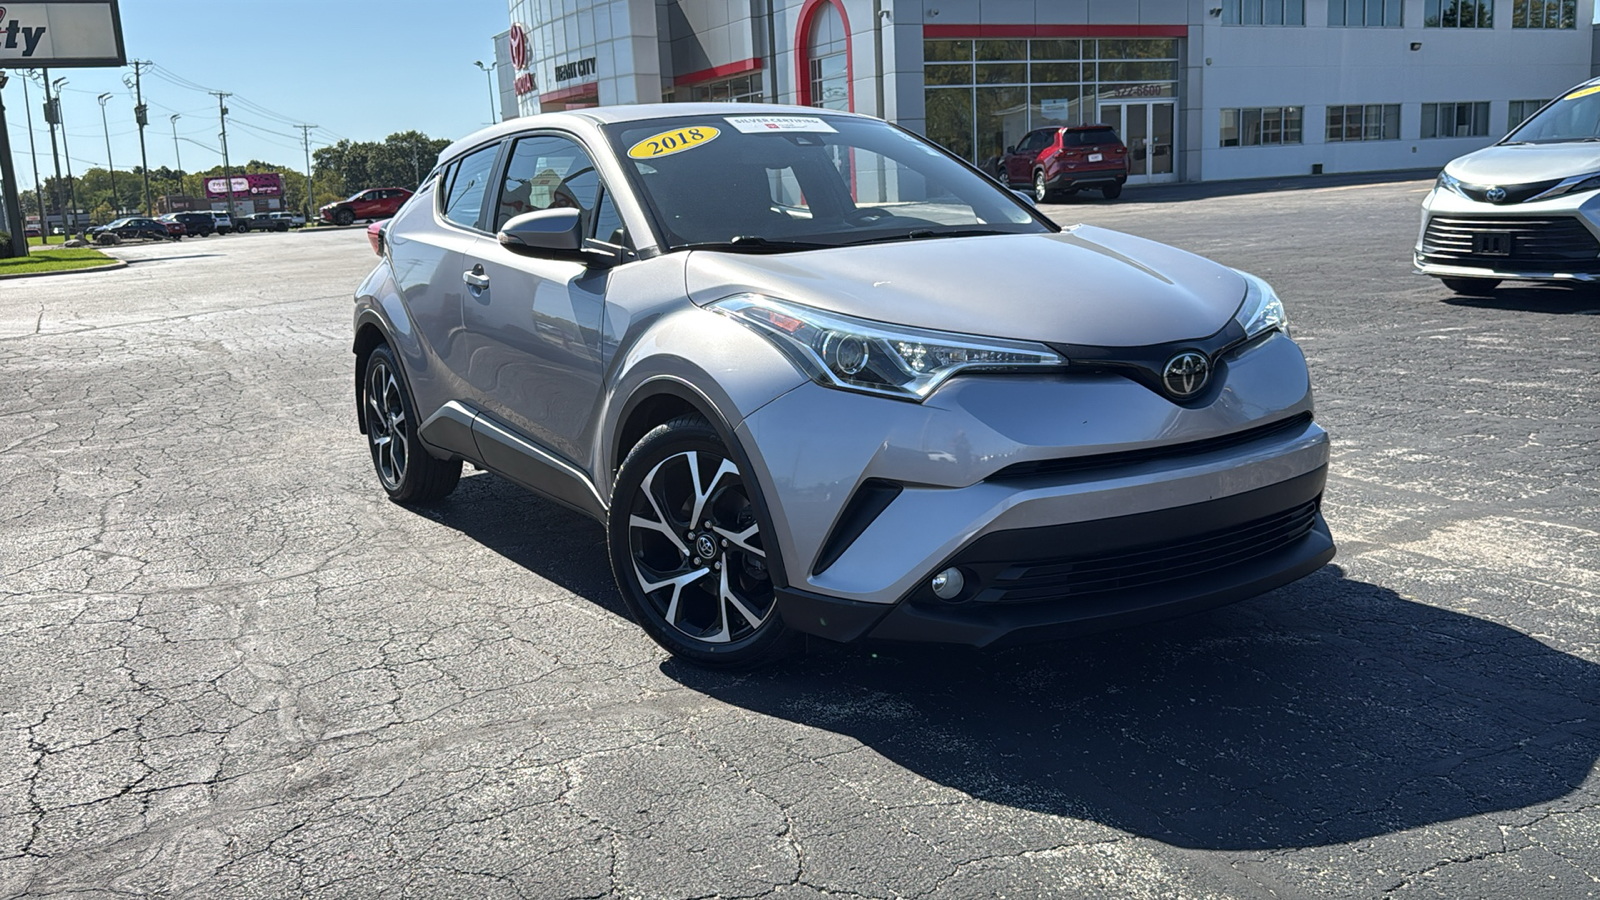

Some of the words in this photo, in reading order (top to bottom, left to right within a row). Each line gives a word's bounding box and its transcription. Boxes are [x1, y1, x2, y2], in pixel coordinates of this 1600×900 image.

[0, 20, 46, 57] ty
[578, 57, 596, 77] CITY
[646, 128, 705, 155] 2018
